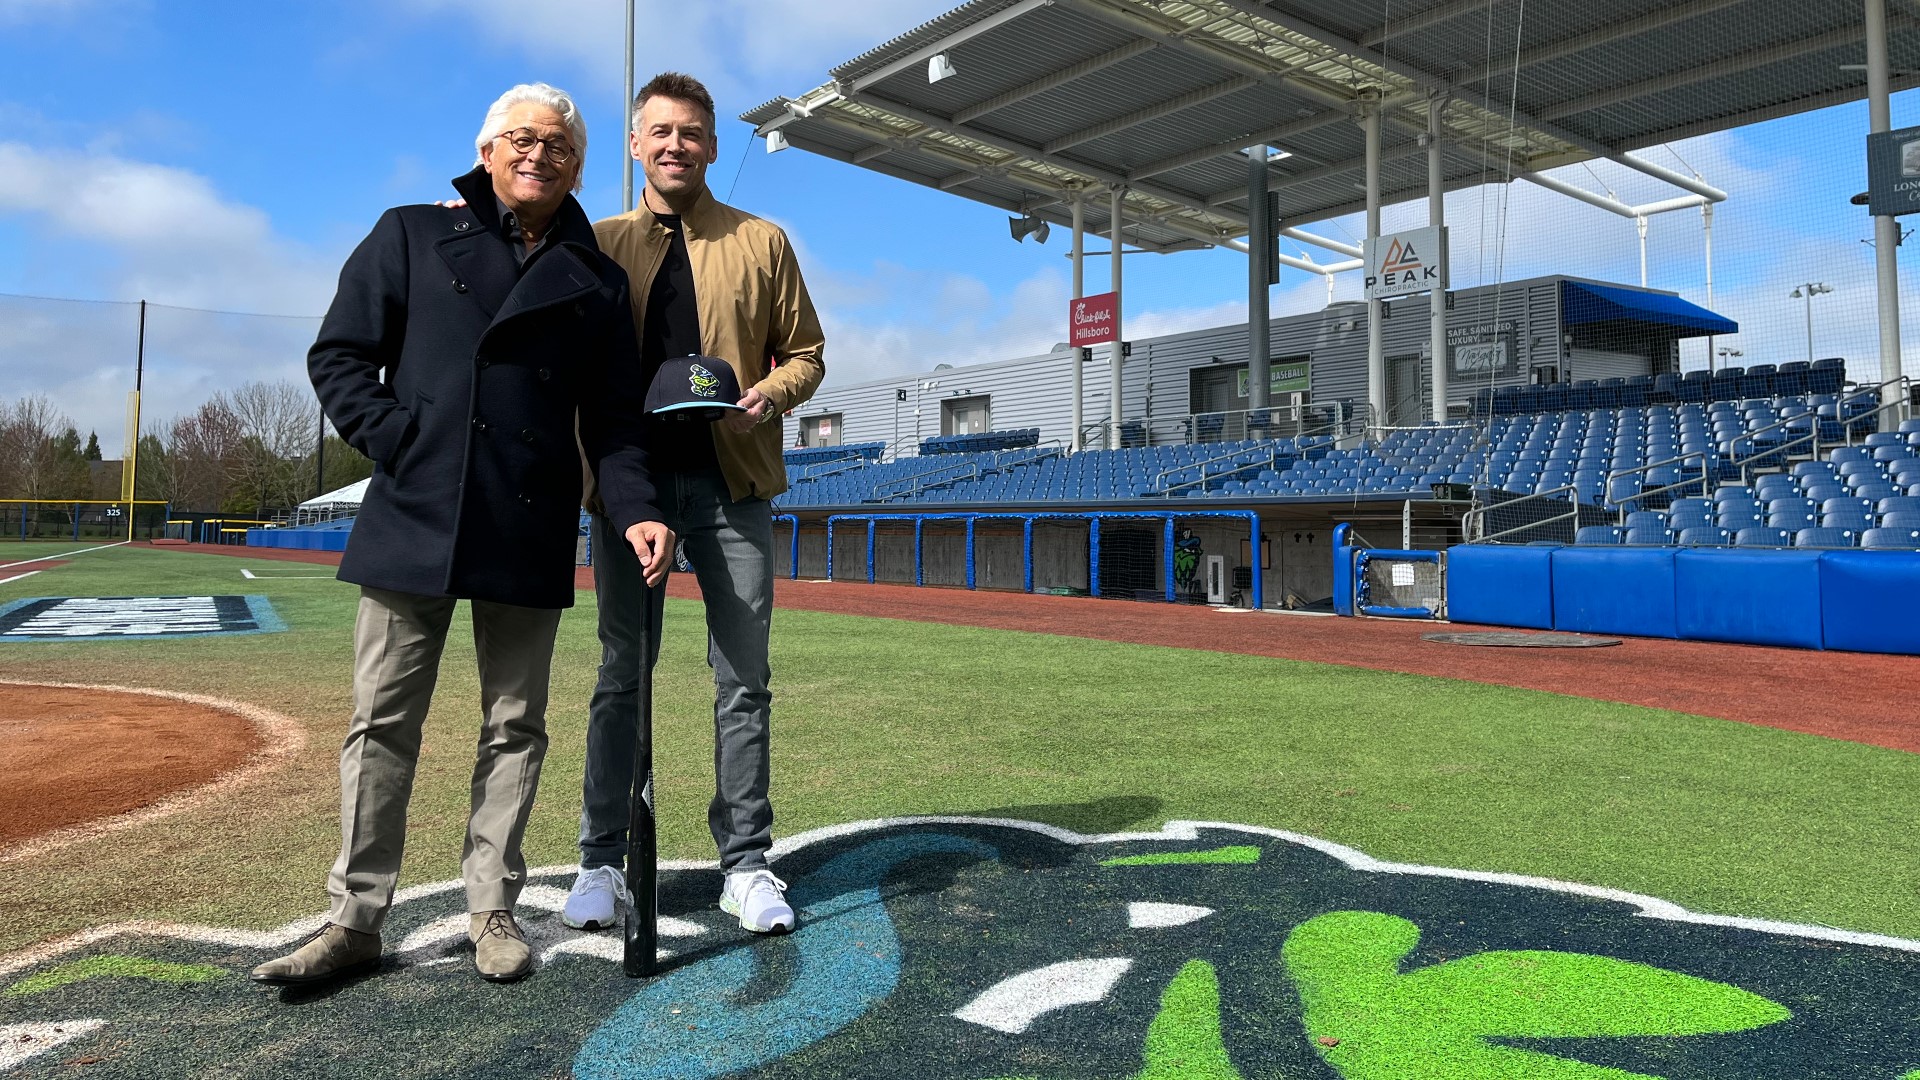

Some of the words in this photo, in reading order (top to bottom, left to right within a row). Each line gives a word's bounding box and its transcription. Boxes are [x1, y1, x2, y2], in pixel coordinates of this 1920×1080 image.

[1893, 180, 1920, 192] LON
[1365, 265, 1437, 289] PEAK
[1374, 281, 1429, 295] CHIROPRACTIC
[1076, 326, 1110, 340] Hillsboro
[1447, 327, 1469, 338] SAFE.
[1470, 322, 1514, 335] SANITIZED.
[1271, 367, 1304, 381] BASEBALL
[106, 508, 121, 517] 325
